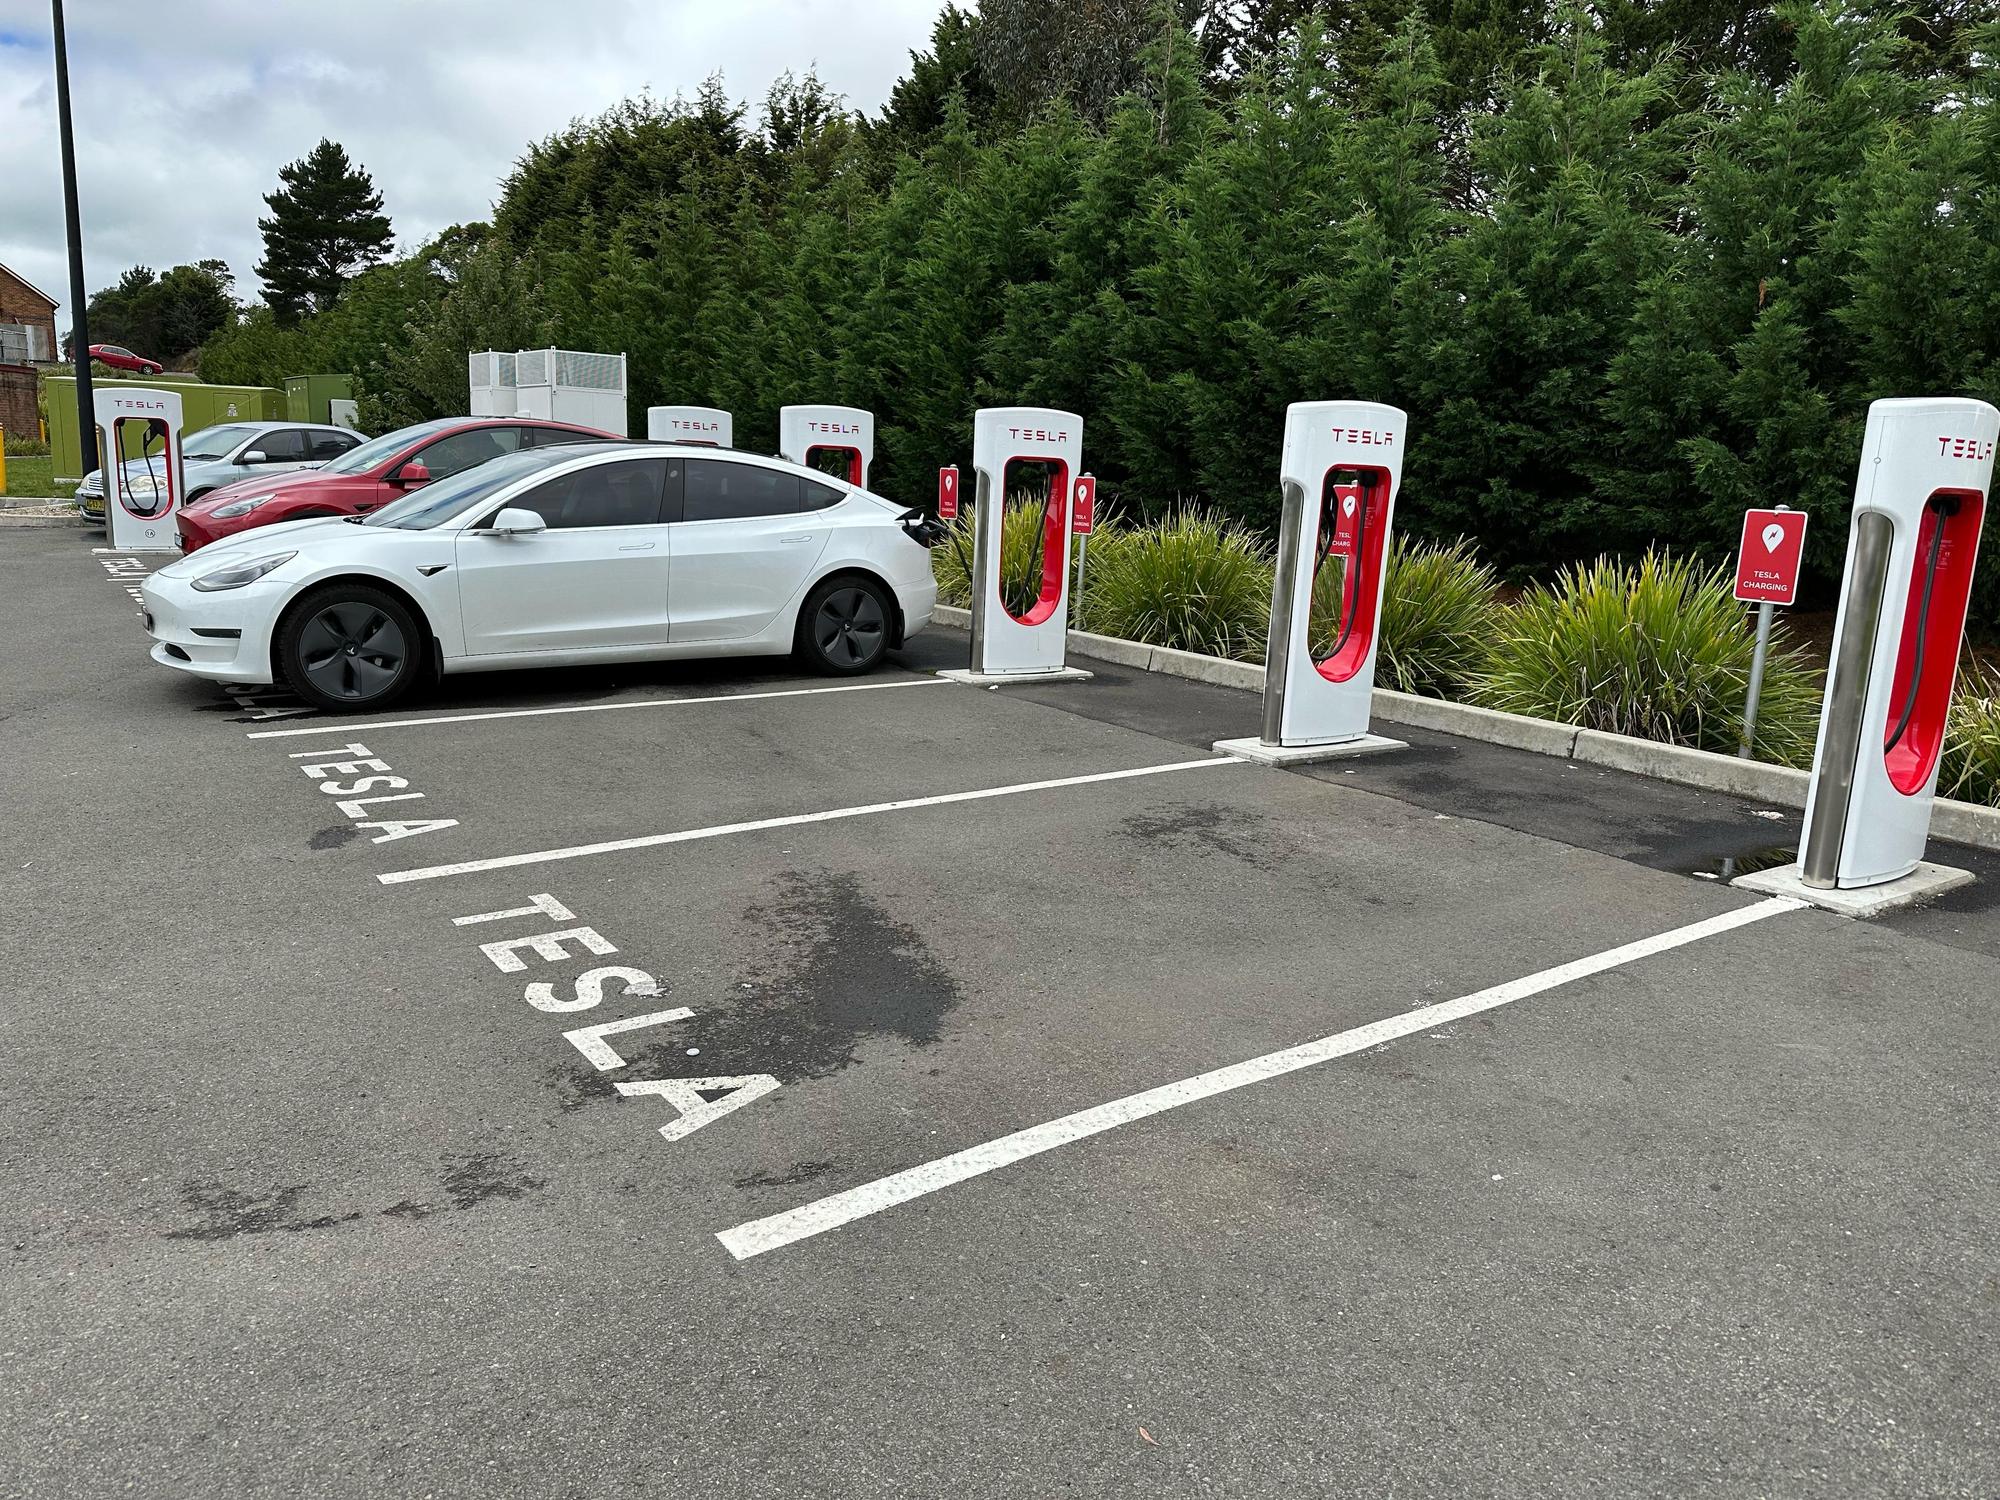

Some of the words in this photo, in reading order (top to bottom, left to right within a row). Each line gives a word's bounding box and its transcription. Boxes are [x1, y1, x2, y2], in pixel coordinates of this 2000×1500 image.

[114, 400, 164, 409] TESLA
[671, 420, 718, 431] TESLA
[808, 422, 860, 434] TESLA
[1009, 428, 1067, 442] TESLA
[1332, 428, 1394, 446] TESLA
[1938, 437, 1993, 461] TESLA
[1753, 570, 1780, 580] TESLA
[1743, 580, 1788, 592] CHARGING
[288, 743, 460, 844] TESLA
[451, 893, 782, 1142] TESLA
